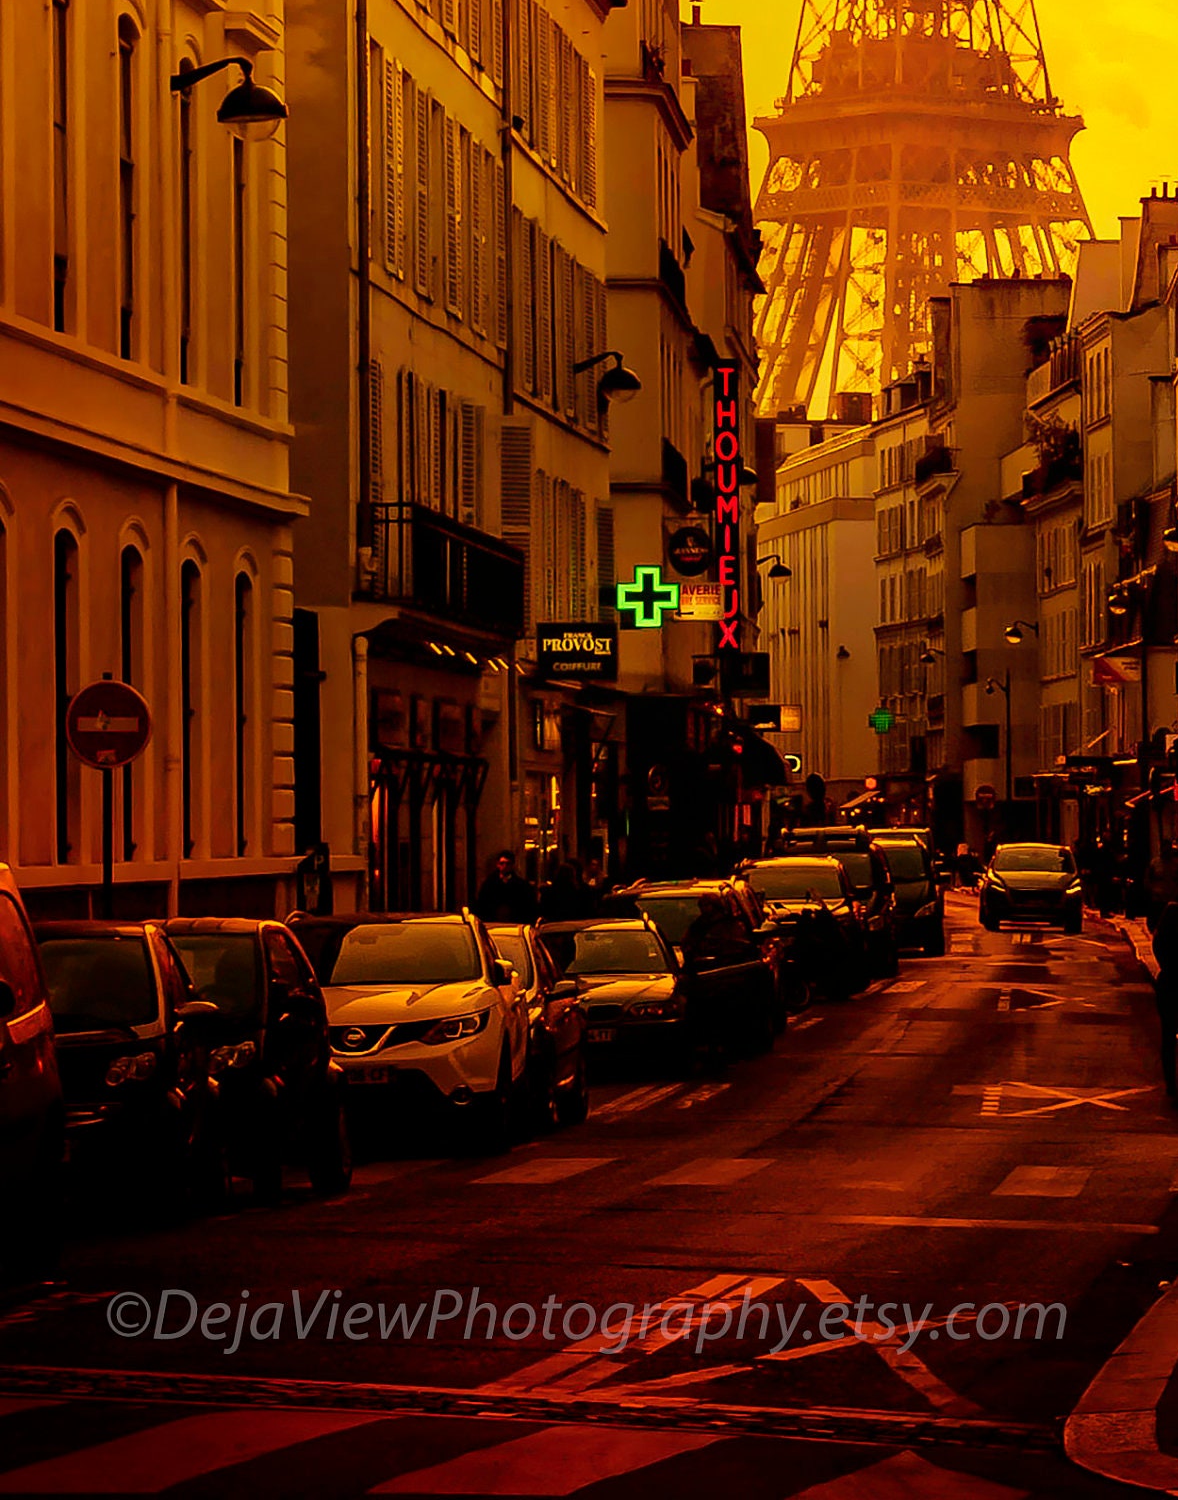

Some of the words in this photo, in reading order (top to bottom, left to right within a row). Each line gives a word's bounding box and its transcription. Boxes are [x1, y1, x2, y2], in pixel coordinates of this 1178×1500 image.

[715, 366, 739, 650] THOUMIEUX
[681, 584, 722, 596] AVERIE
[542, 637, 612, 655] PROVOST
